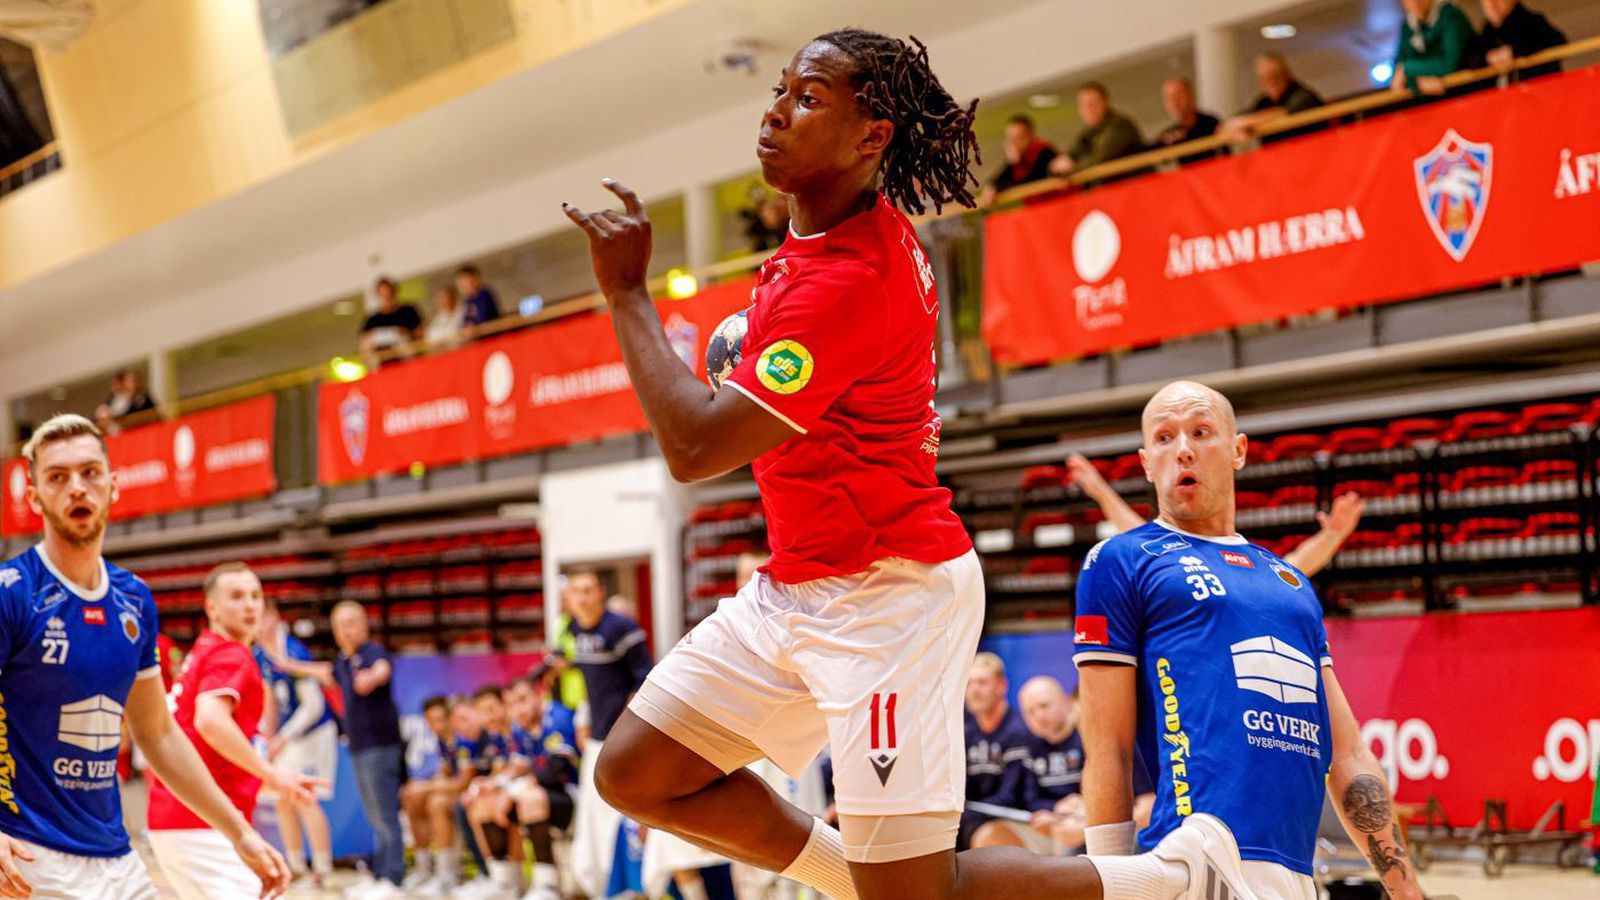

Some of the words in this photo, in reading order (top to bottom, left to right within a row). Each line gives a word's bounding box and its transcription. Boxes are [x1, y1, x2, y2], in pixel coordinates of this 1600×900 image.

[1164, 223, 1255, 279] ÁFRAM
[1257, 205, 1366, 259] HÆRRA
[1185, 573, 1227, 601] 33
[41, 638, 70, 665] 27
[869, 692, 897, 749] 11
[1156, 657, 1193, 817] GOODYEAR
[1242, 709, 1275, 733] GG
[1275, 713, 1320, 745] VERK
[53, 757, 84, 778] GG
